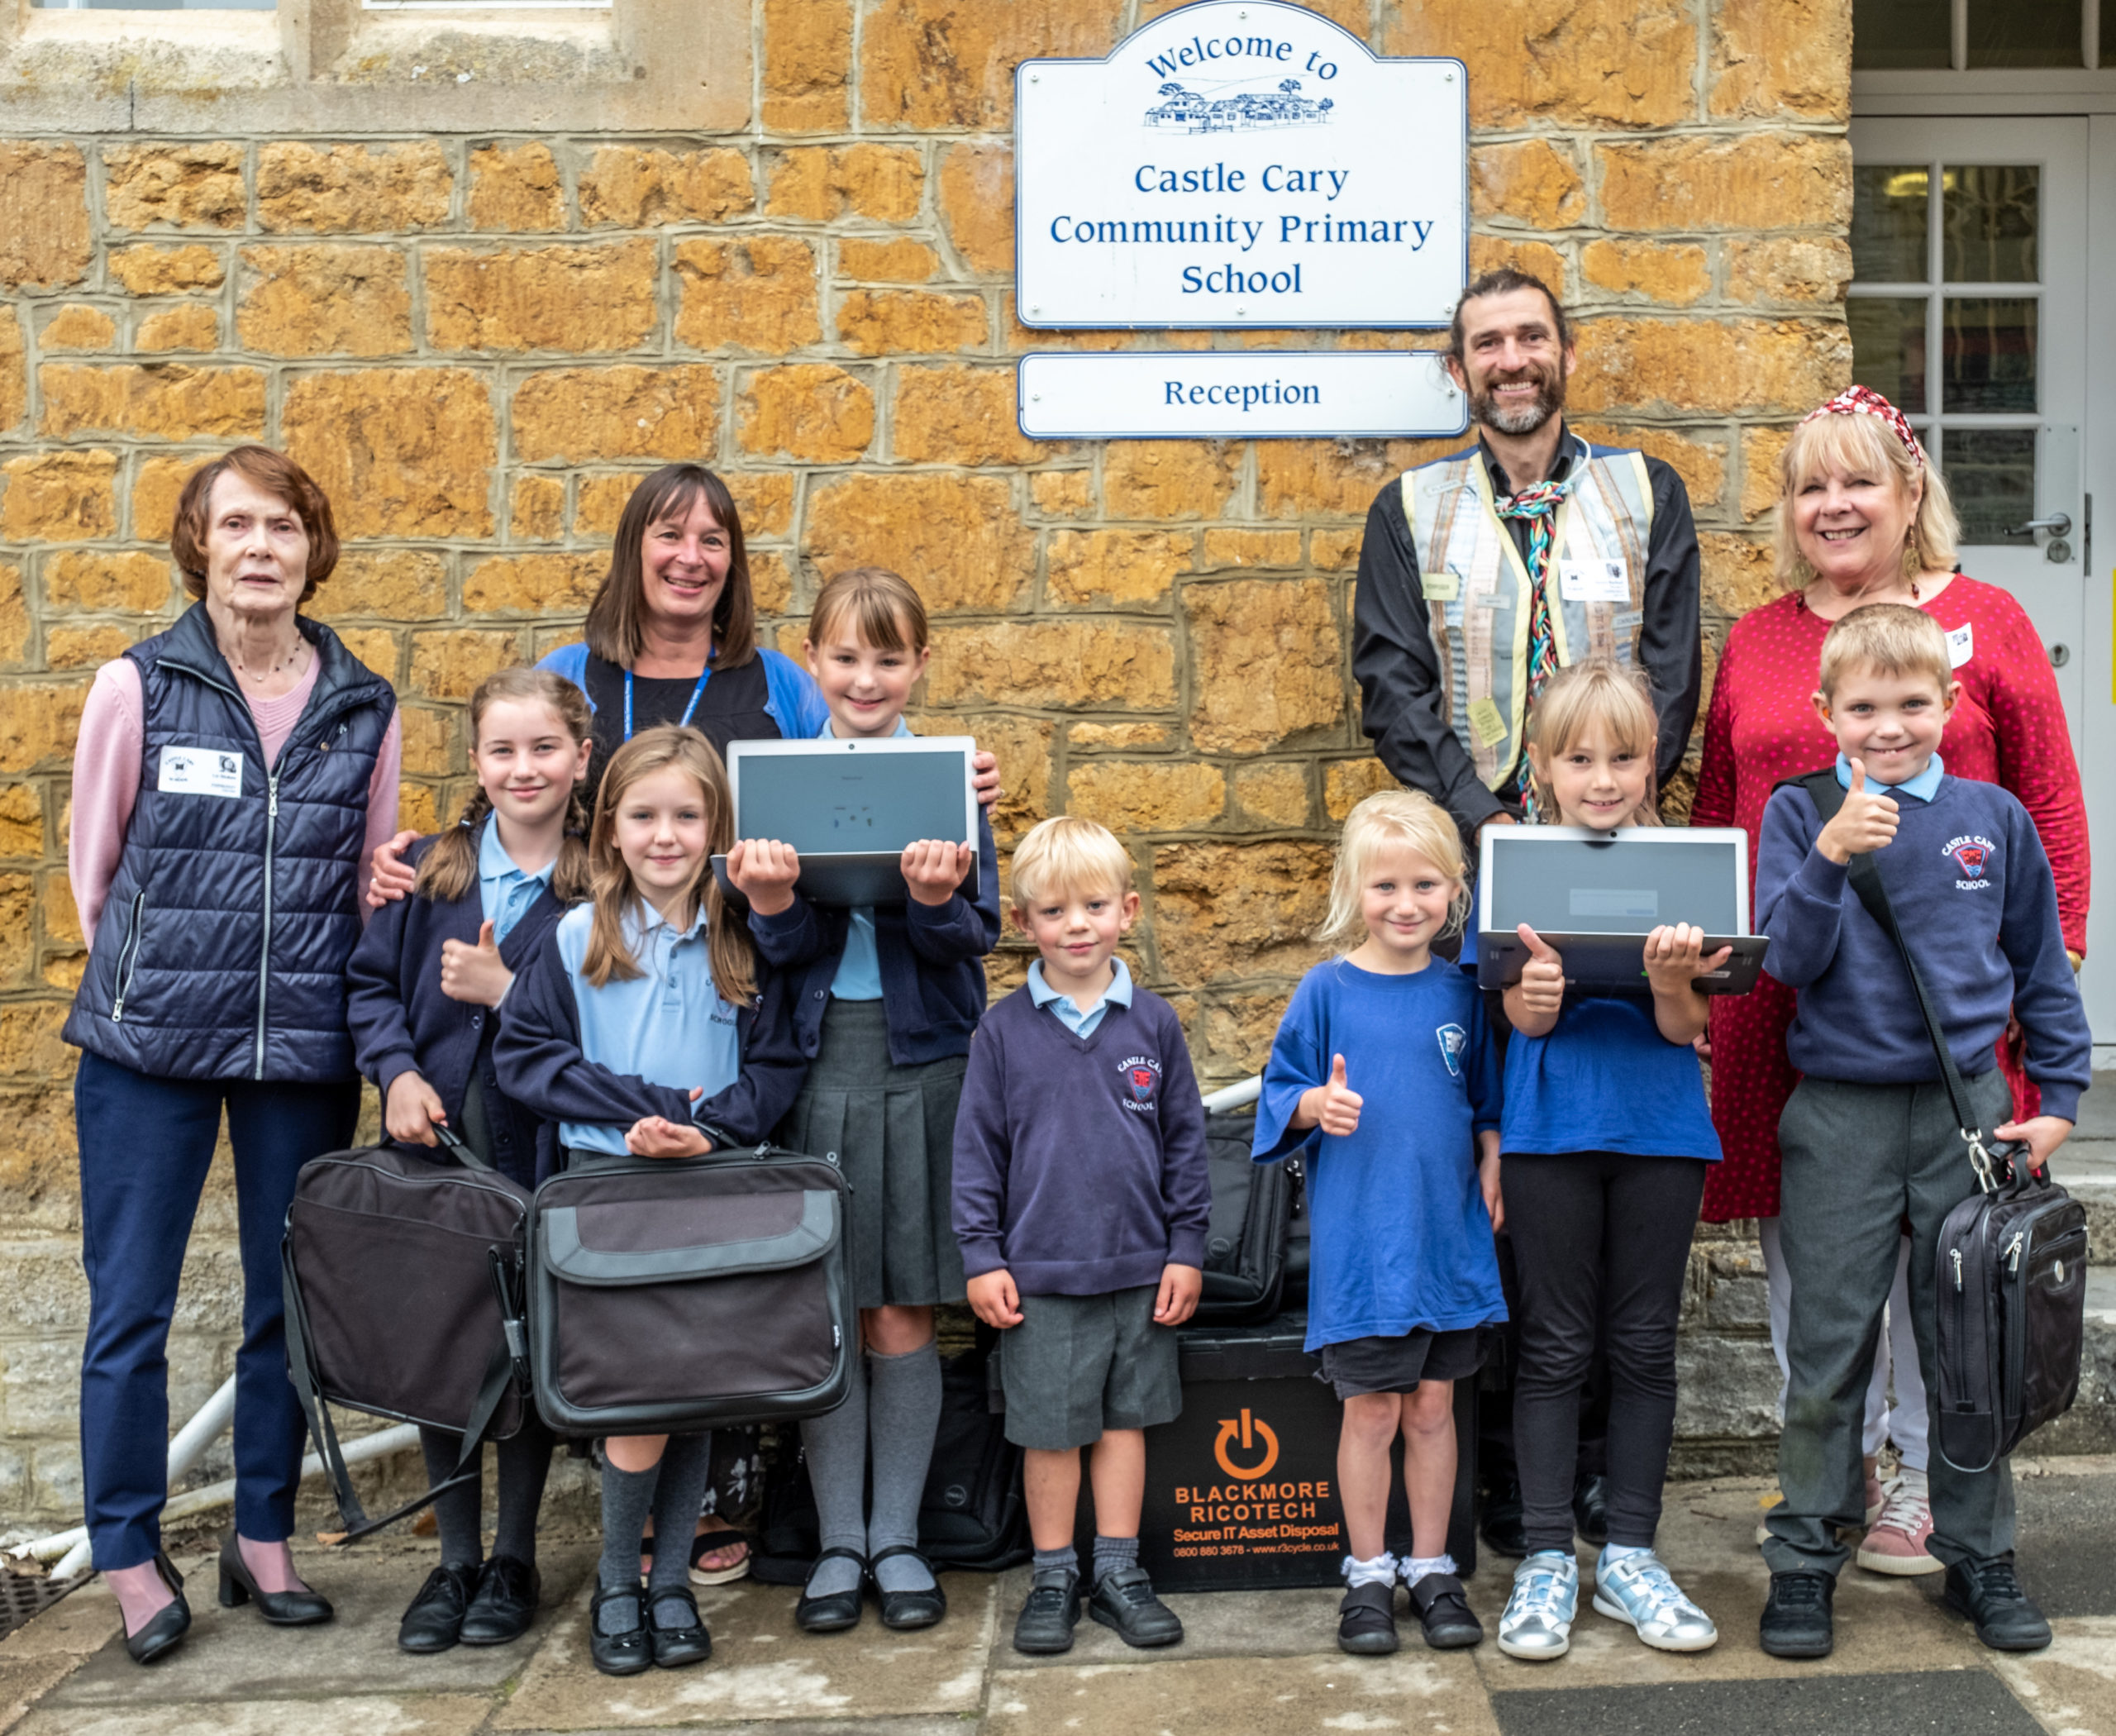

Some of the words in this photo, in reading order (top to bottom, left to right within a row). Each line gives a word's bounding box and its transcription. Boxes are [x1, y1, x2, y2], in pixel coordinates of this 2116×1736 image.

[1146, 36, 1293, 80] Welcome
[1305, 51, 1338, 80] to
[1135, 163, 1246, 193] Castle
[1261, 165, 1349, 201] Cary
[1051, 214, 1263, 252] Community
[1280, 214, 1434, 252] Primary
[1182, 264, 1303, 293] School
[1164, 379, 1320, 412] Reception
[1942, 836, 1971, 856] CASTLE
[1956, 879, 1990, 890] SCHOOL
[1118, 1056, 1146, 1071] CASTLE
[1122, 1098, 1155, 1110] SCHOOL
[1175, 1481, 1330, 1504] BLACKMORE
[1190, 1502, 1316, 1523] RICOTECH
[1174, 1528, 1222, 1542] Secure
[1223, 1526, 1237, 1540] IT
[1238, 1525, 1278, 1539] Asset
[1280, 1522, 1339, 1540] Disposal
[1174, 1547, 1198, 1557] 0800
[1252, 1542, 1339, 1554] www.r3cycle.co.uk
